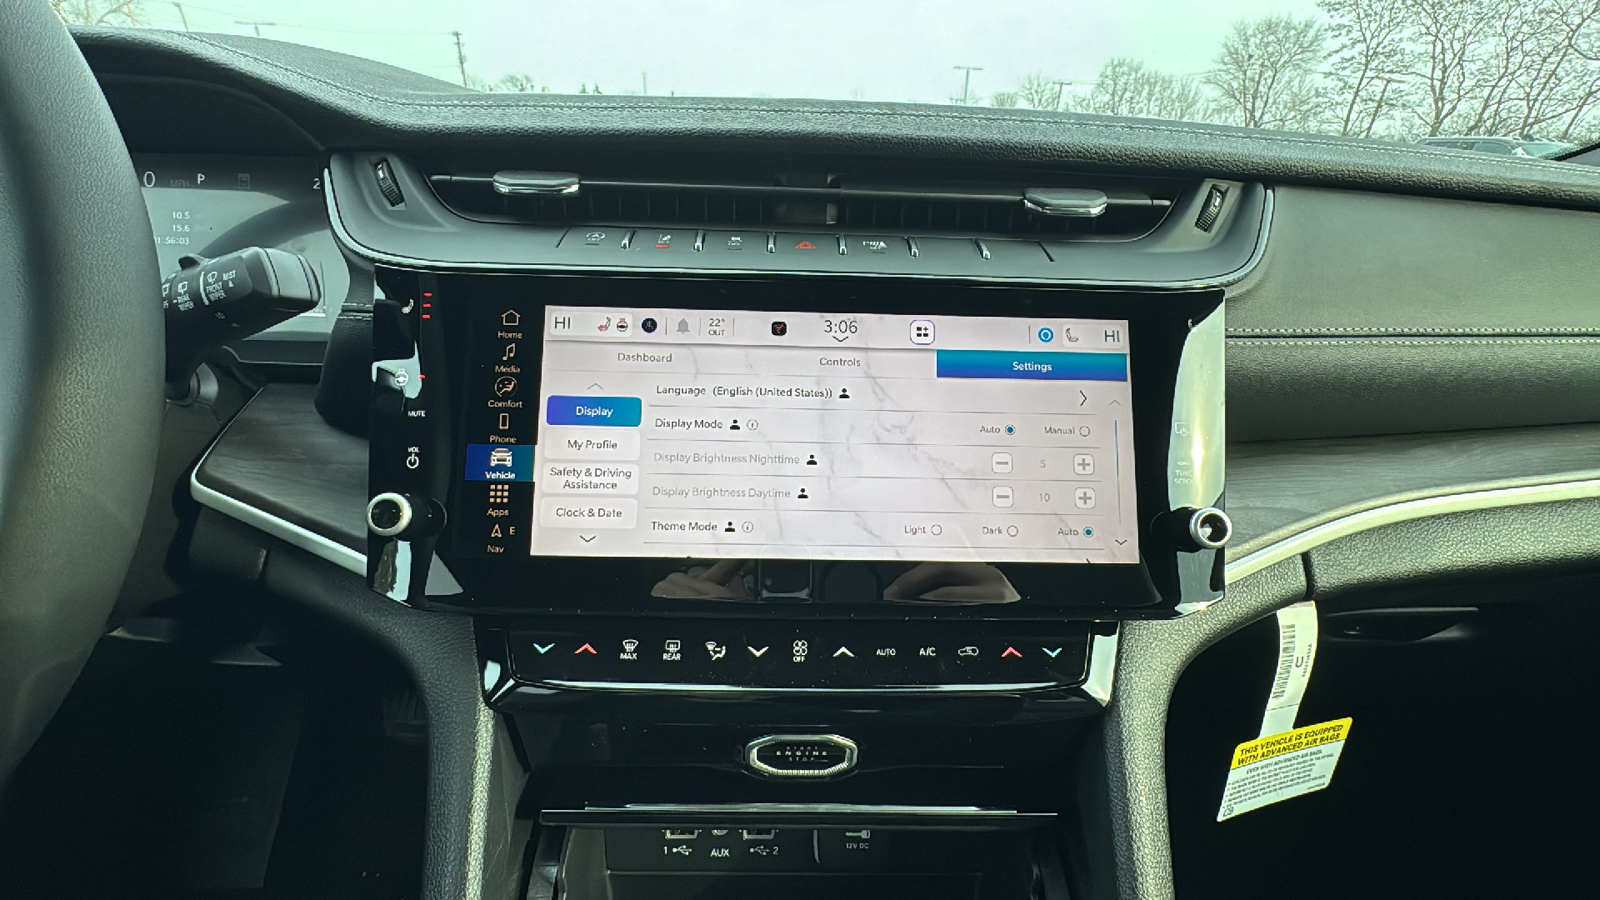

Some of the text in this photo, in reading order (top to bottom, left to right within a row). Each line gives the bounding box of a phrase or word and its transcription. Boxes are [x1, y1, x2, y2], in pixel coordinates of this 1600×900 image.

[143, 171, 156, 188] 0
[196, 173, 206, 185] P
[172, 211, 191, 220] 10.5
[172, 224, 191, 233] 15.6
[154, 236, 190, 246] 1:56:03
[554, 316, 571, 330] HI
[708, 318, 726, 327] 22°
[823, 319, 859, 334] 3:06
[497, 331, 523, 339] Home
[1104, 329, 1120, 343] HI
[617, 352, 673, 363] Dashboard
[819, 357, 861, 367] Controls
[494, 364, 521, 374] Media
[1012, 361, 1053, 373] Settings
[656, 385, 833, 398] Language (English (United States))
[487, 399, 523, 409] Comfort
[575, 406, 614, 418] Display
[655, 418, 723, 430] Display Mode
[979, 425, 1001, 434] Auto
[1044, 426, 1076, 435] Manual
[489, 434, 517, 444] Phone
[567, 440, 618, 451] My Profile
[653, 452, 800, 466] Display Brightness Nighttime
[1039, 459, 1046, 469] 5
[485, 471, 516, 480] Vehicle
[550, 467, 632, 480] Safety & Driving
[563, 480, 618, 490] Assistance
[652, 486, 791, 499] Display Brightness Daytime
[1038, 493, 1051, 503] 10
[486, 507, 509, 517] Apps
[555, 507, 623, 518] Clock & Date
[651, 521, 718, 531] Theme Mode
[904, 525, 927, 536] Light
[982, 526, 1003, 535] Dark
[1057, 527, 1079, 536] Auto
[487, 545, 504, 553] Nav
[620, 652, 637, 660] MAX
[876, 648, 896, 656] AUTO
[919, 647, 936, 656] A/C
[662, 653, 681, 661] REAR
[1240, 724, 1344, 756] THIS VEHICLE IS EQUIPPED
[1237, 733, 1341, 766] WITH ADVANCED AIR BAGS
[663, 846, 668, 855] 1
[710, 848, 730, 857] AUX
[773, 847, 779, 855] 2
